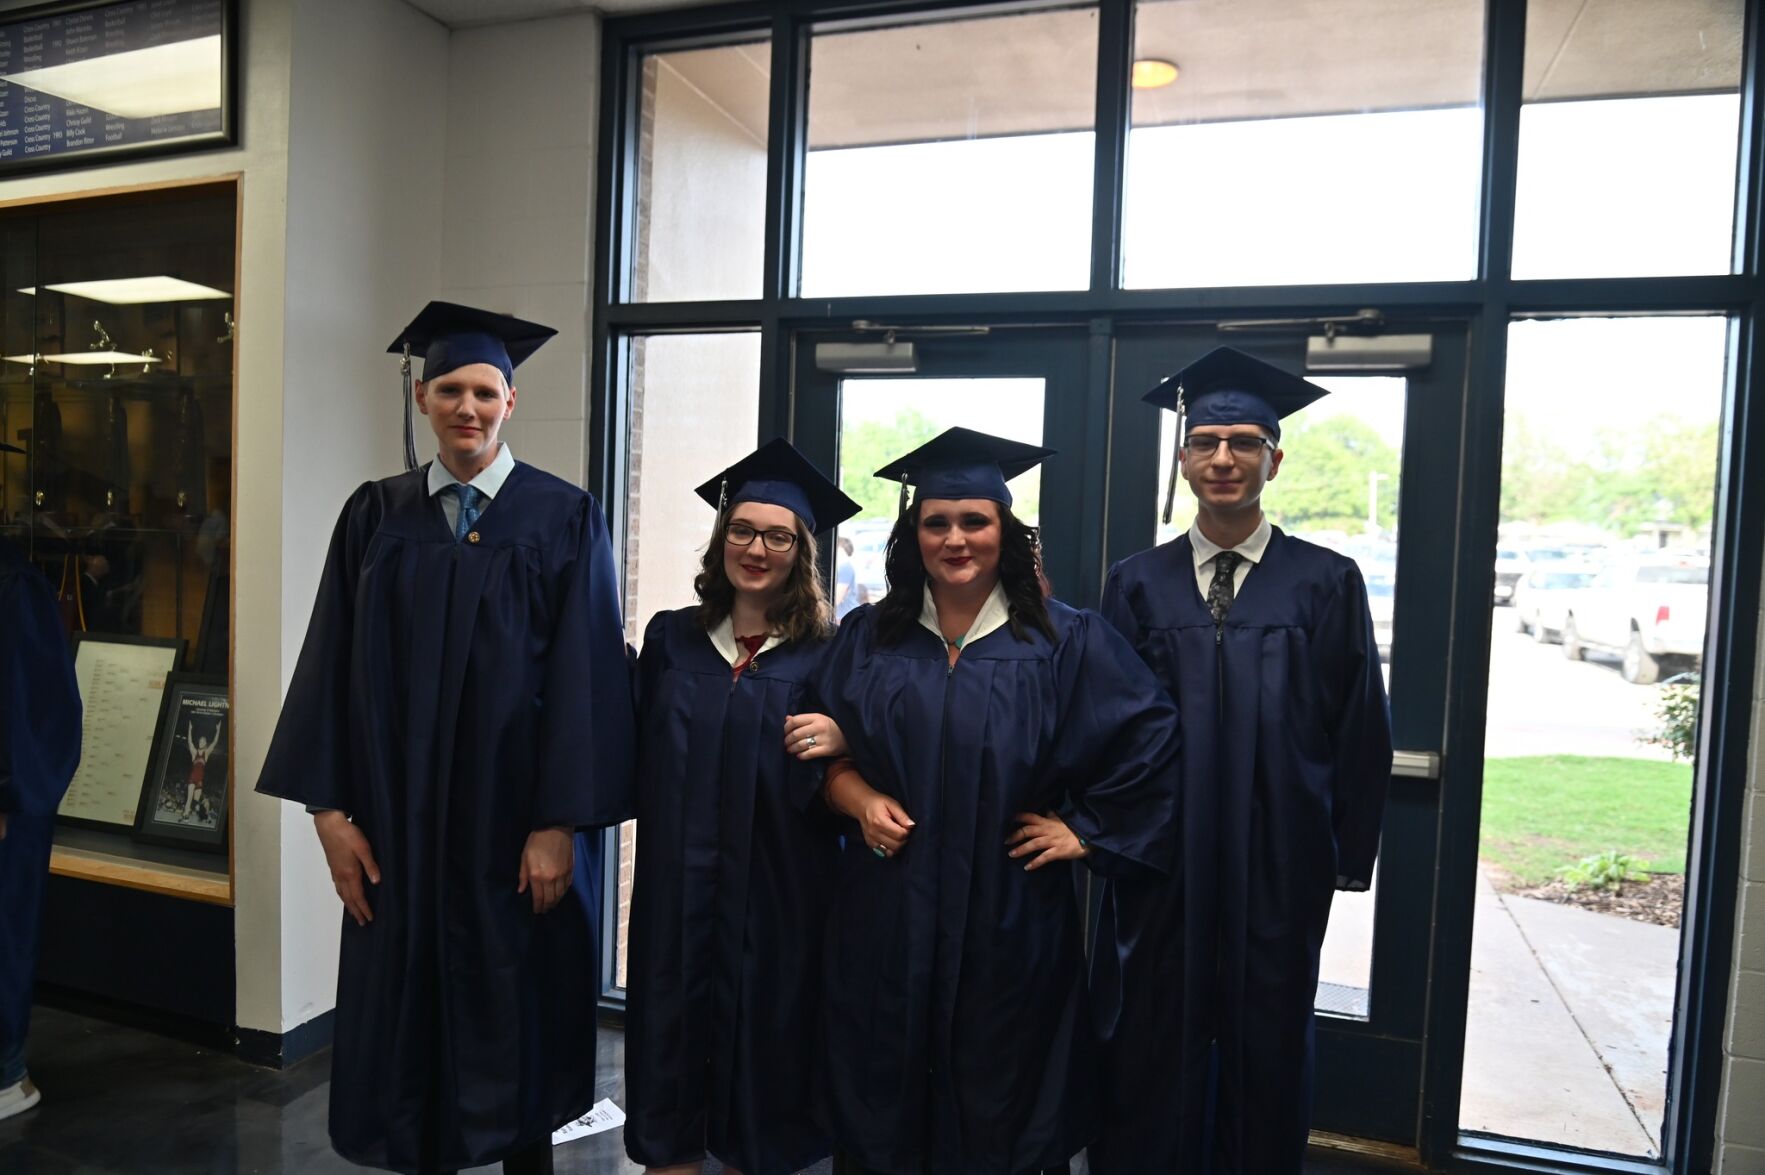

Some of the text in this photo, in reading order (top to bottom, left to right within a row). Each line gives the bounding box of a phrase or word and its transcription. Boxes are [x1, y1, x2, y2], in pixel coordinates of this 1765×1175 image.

[24, 104, 51, 114] Cross Country
[35, 114, 51, 122] Country
[35, 124, 51, 132] Country
[35, 134, 51, 142] Country
[24, 143, 51, 154] Cross Country
[182, 698, 207, 706] MICHAEL
